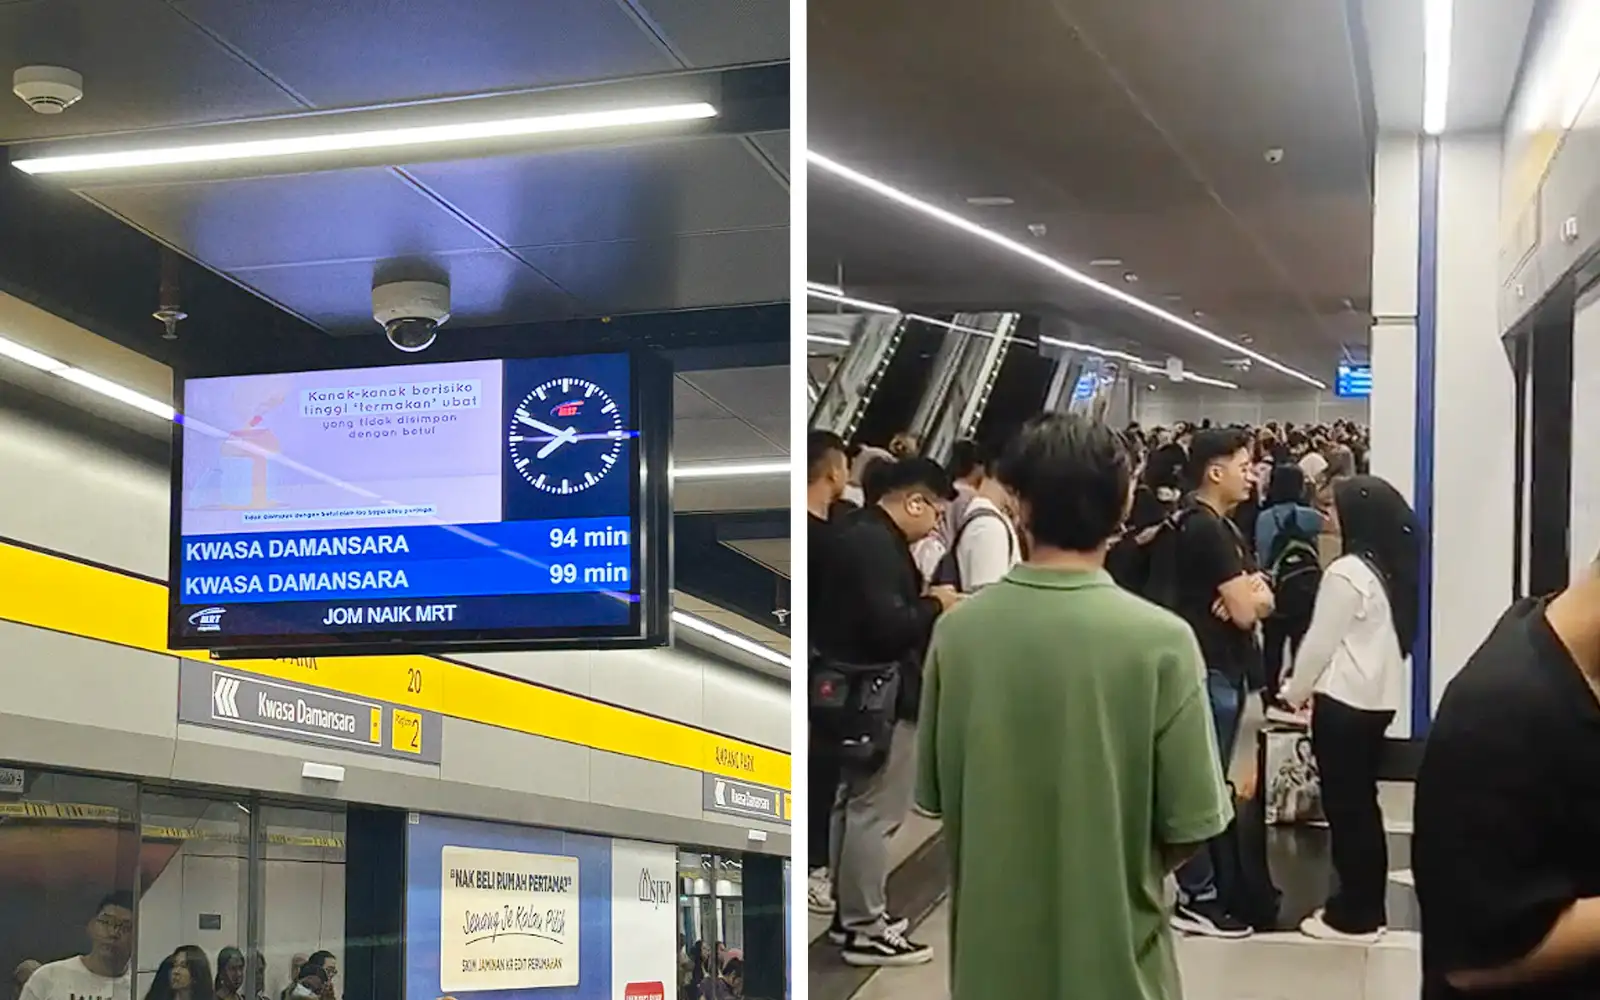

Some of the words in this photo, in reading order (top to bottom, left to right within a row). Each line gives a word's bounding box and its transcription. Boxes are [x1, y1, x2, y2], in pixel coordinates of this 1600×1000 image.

[308, 386, 406, 402] Kanak-kanak
[412, 383, 473, 396] berisiko
[304, 402, 348, 416] tinggi
[442, 396, 477, 408] ubat
[359, 417, 392, 427] tidak
[397, 413, 457, 425] disimpan
[186, 541, 264, 561] KWASA
[268, 534, 410, 558] DAMANSARA
[549, 527, 578, 548] 94
[584, 525, 629, 547] min
[185, 574, 263, 595] KWASA
[268, 570, 409, 593] DAMANSARA
[549, 563, 577, 584] 99
[584, 562, 628, 583] min
[322, 607, 363, 625] JOM
[367, 605, 412, 624] NAIK
[416, 604, 457, 622] MRT
[407, 668, 422, 694] 20
[258, 691, 295, 722] Kwasa
[297, 699, 356, 733] Damansara
[410, 718, 420, 748] 2
[476, 870, 496, 890] BELI
[496, 871, 528, 891] RUMAH
